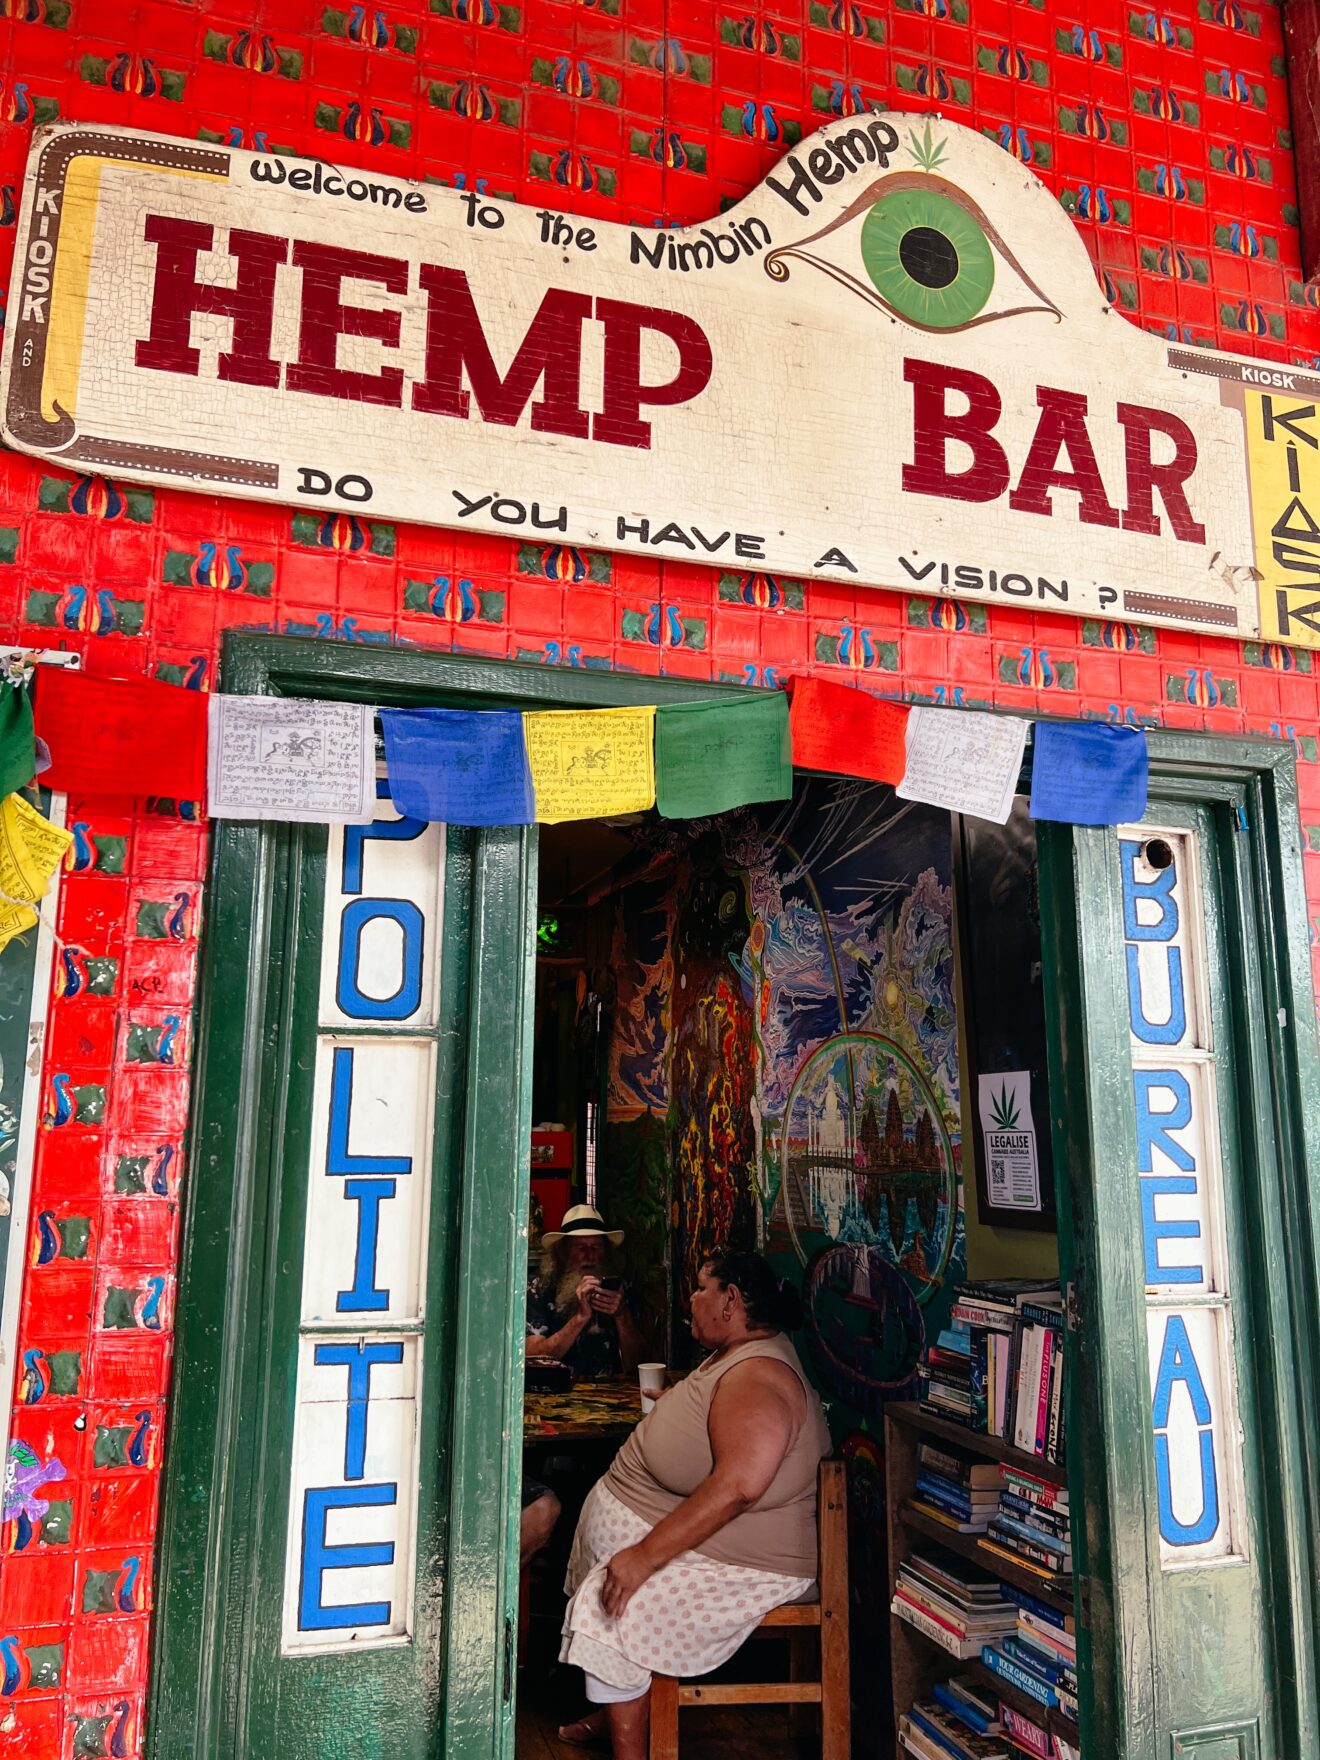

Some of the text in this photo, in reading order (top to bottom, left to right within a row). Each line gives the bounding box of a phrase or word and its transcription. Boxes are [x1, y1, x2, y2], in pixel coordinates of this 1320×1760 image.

[21, 187, 61, 325] KIOSK
[460, 192, 505, 230] to
[536, 210, 597, 251] the
[629, 215, 772, 272] Nimbin
[765, 119, 899, 217] Hemp
[21, 338, 34, 367] AND
[134, 214, 1207, 545] HEMP BAR
[1241, 365, 1296, 391] KIOSK
[297, 467, 373, 502] DO
[452, 489, 567, 532] YOU
[617, 516, 766, 559] HAVE
[813, 546, 858, 574] A
[898, 555, 1069, 602] VISION
[298, 778, 430, 1631] POLITE
[990, 1135, 1029, 1149] LEGALISE
[1119, 839, 1219, 1546] BUREAU
[1014, 1667, 1049, 1698] GARDENING
